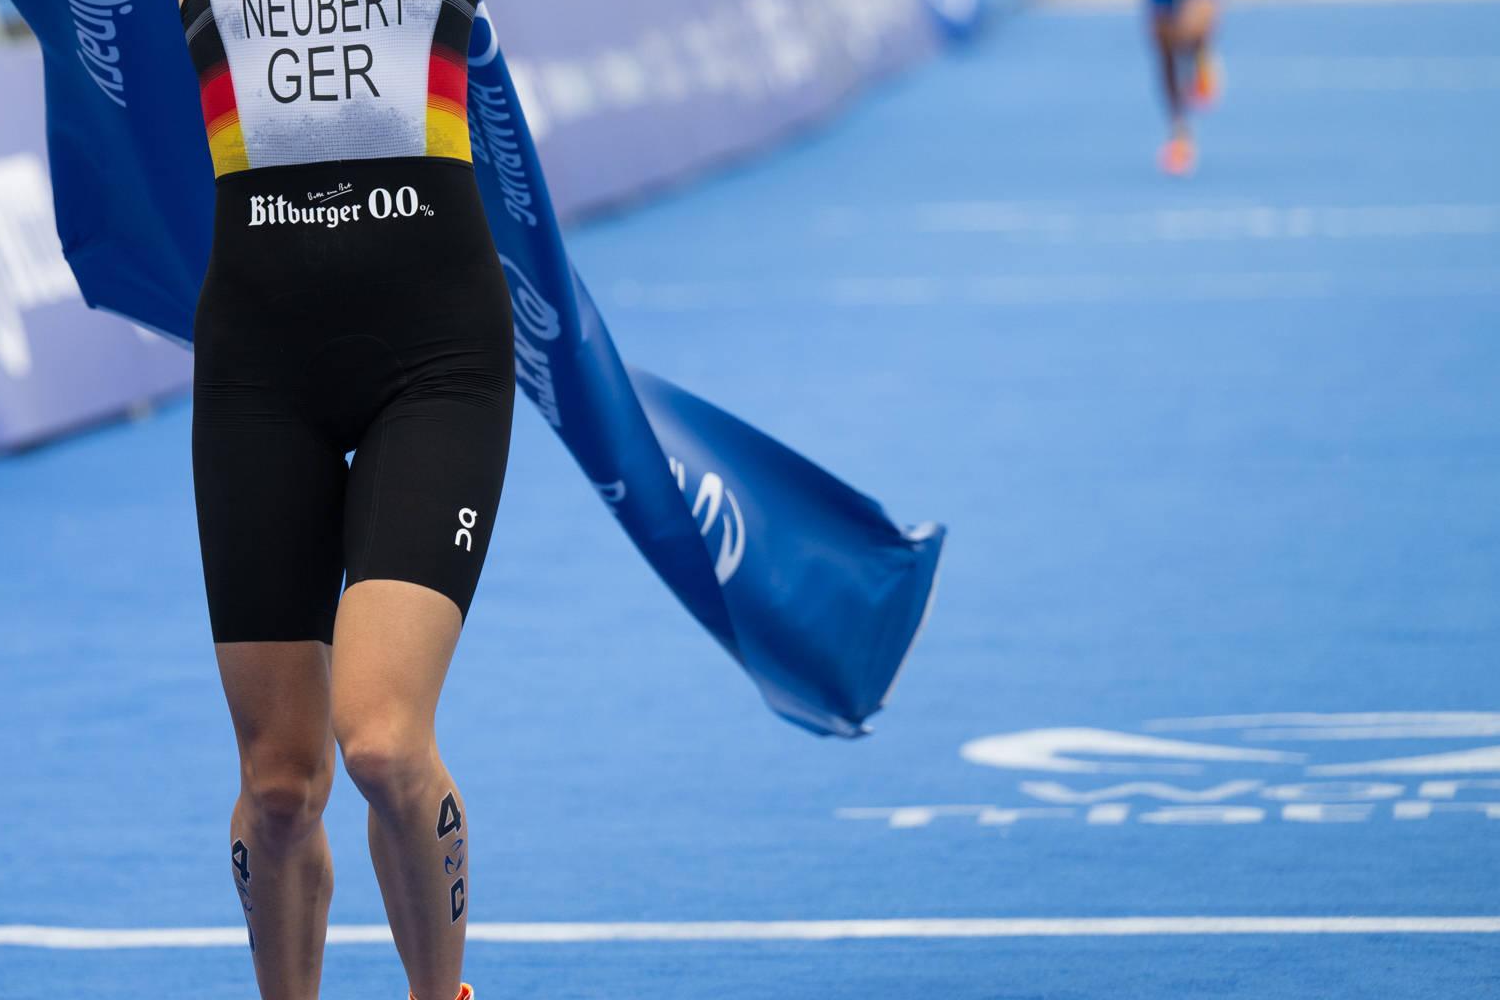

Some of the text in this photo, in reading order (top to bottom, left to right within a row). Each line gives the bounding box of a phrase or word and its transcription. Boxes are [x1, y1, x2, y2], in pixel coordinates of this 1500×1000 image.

[267, 43, 381, 104] GER
[248, 194, 362, 228] Bitburger
[436, 790, 462, 841] 4
